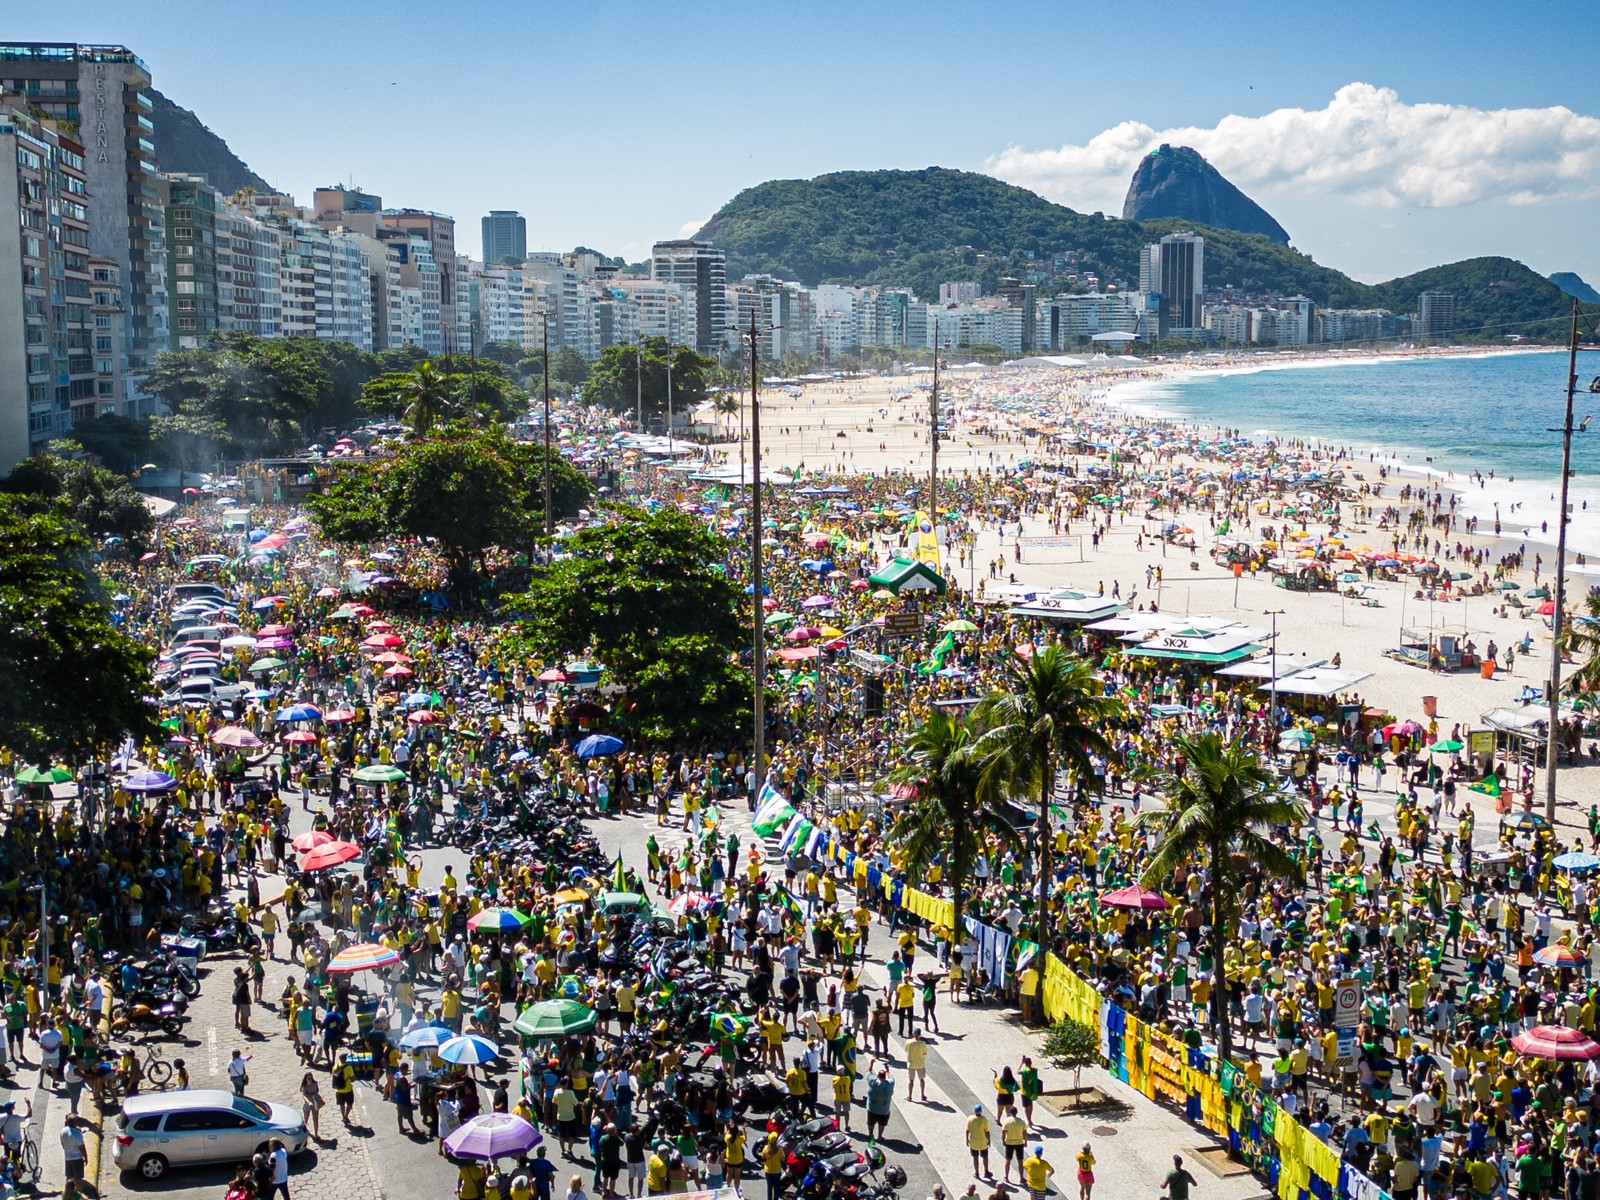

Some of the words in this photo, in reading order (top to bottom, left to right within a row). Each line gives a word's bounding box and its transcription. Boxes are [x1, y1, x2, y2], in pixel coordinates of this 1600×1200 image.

[94, 64, 108, 162] PESTANA
[1041, 598, 1061, 608] SKOL
[1163, 637, 1188, 648] SKOL
[1344, 993, 1353, 1002] 70
[1079, 1159, 1088, 1170] 10
